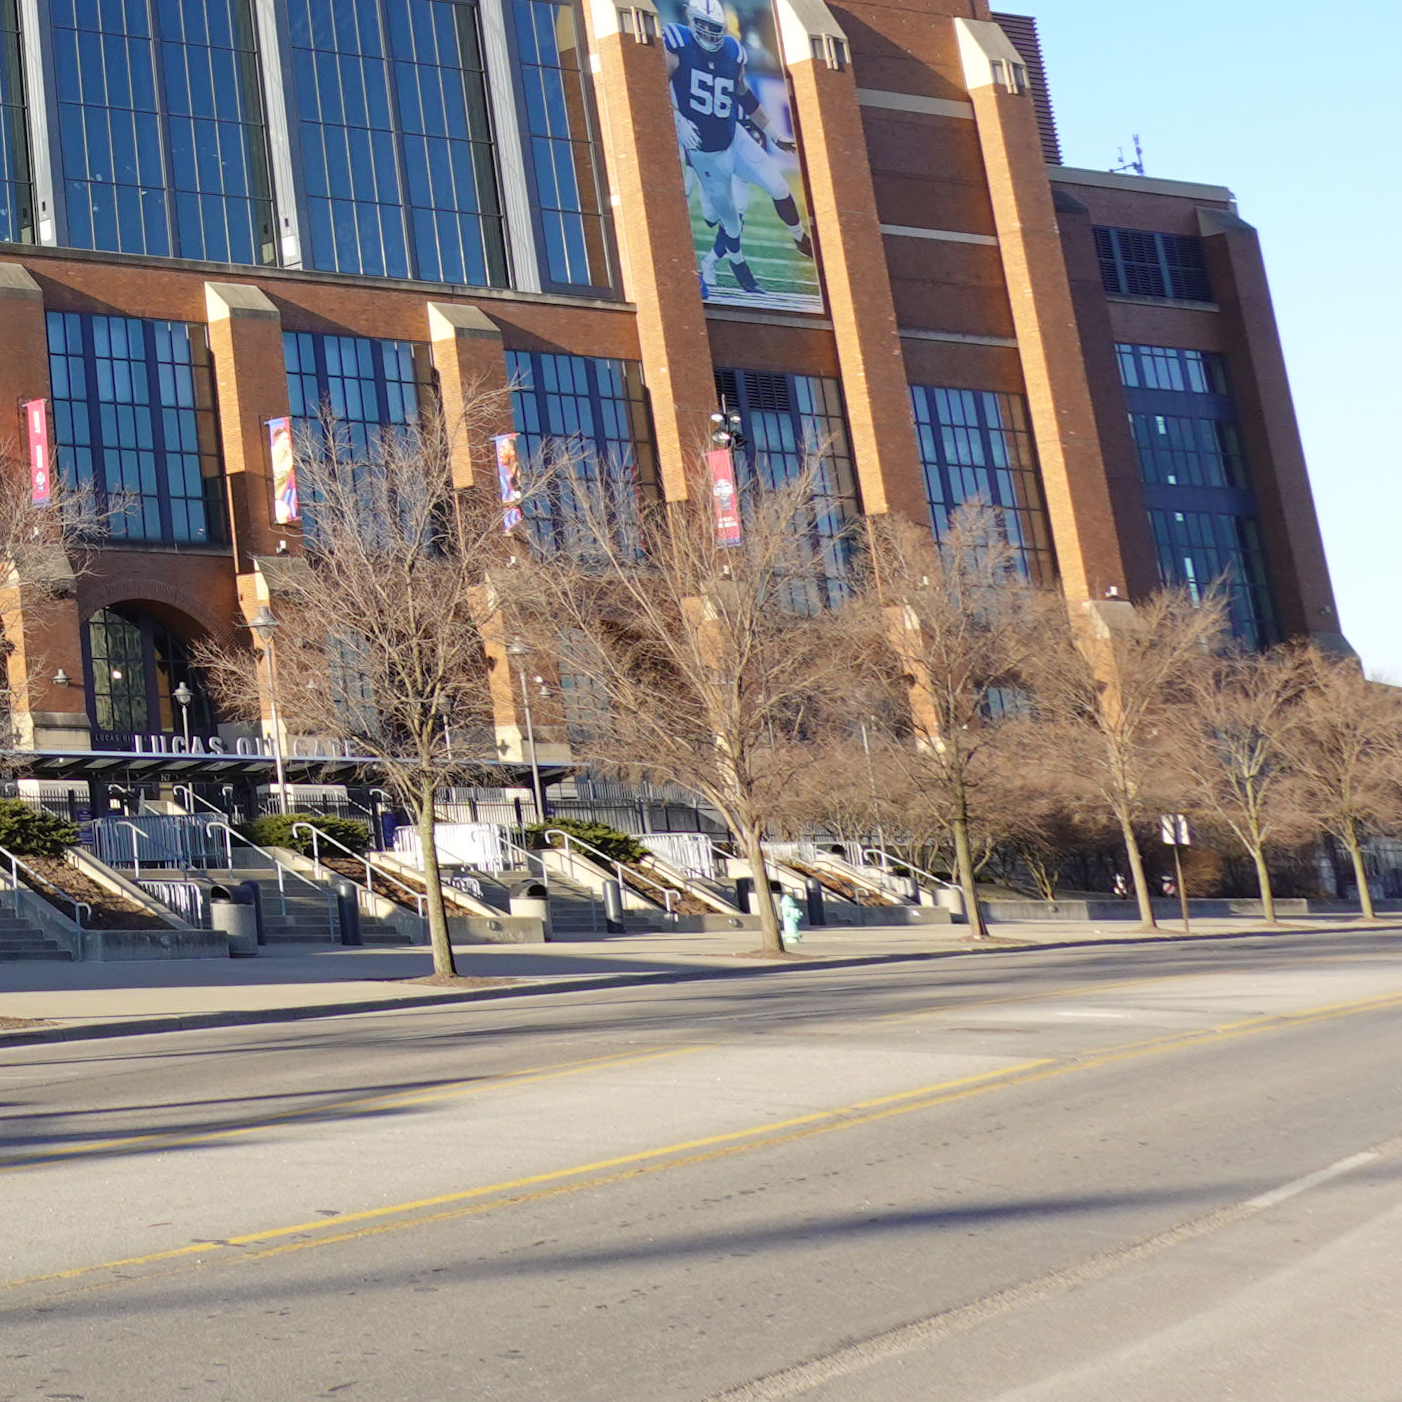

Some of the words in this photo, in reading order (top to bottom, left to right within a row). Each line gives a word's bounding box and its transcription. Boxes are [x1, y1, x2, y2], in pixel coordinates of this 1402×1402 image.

[690, 68, 734, 118] 56
[96, 734, 119, 742] LUCAS
[135, 734, 224, 755] LUCAS
